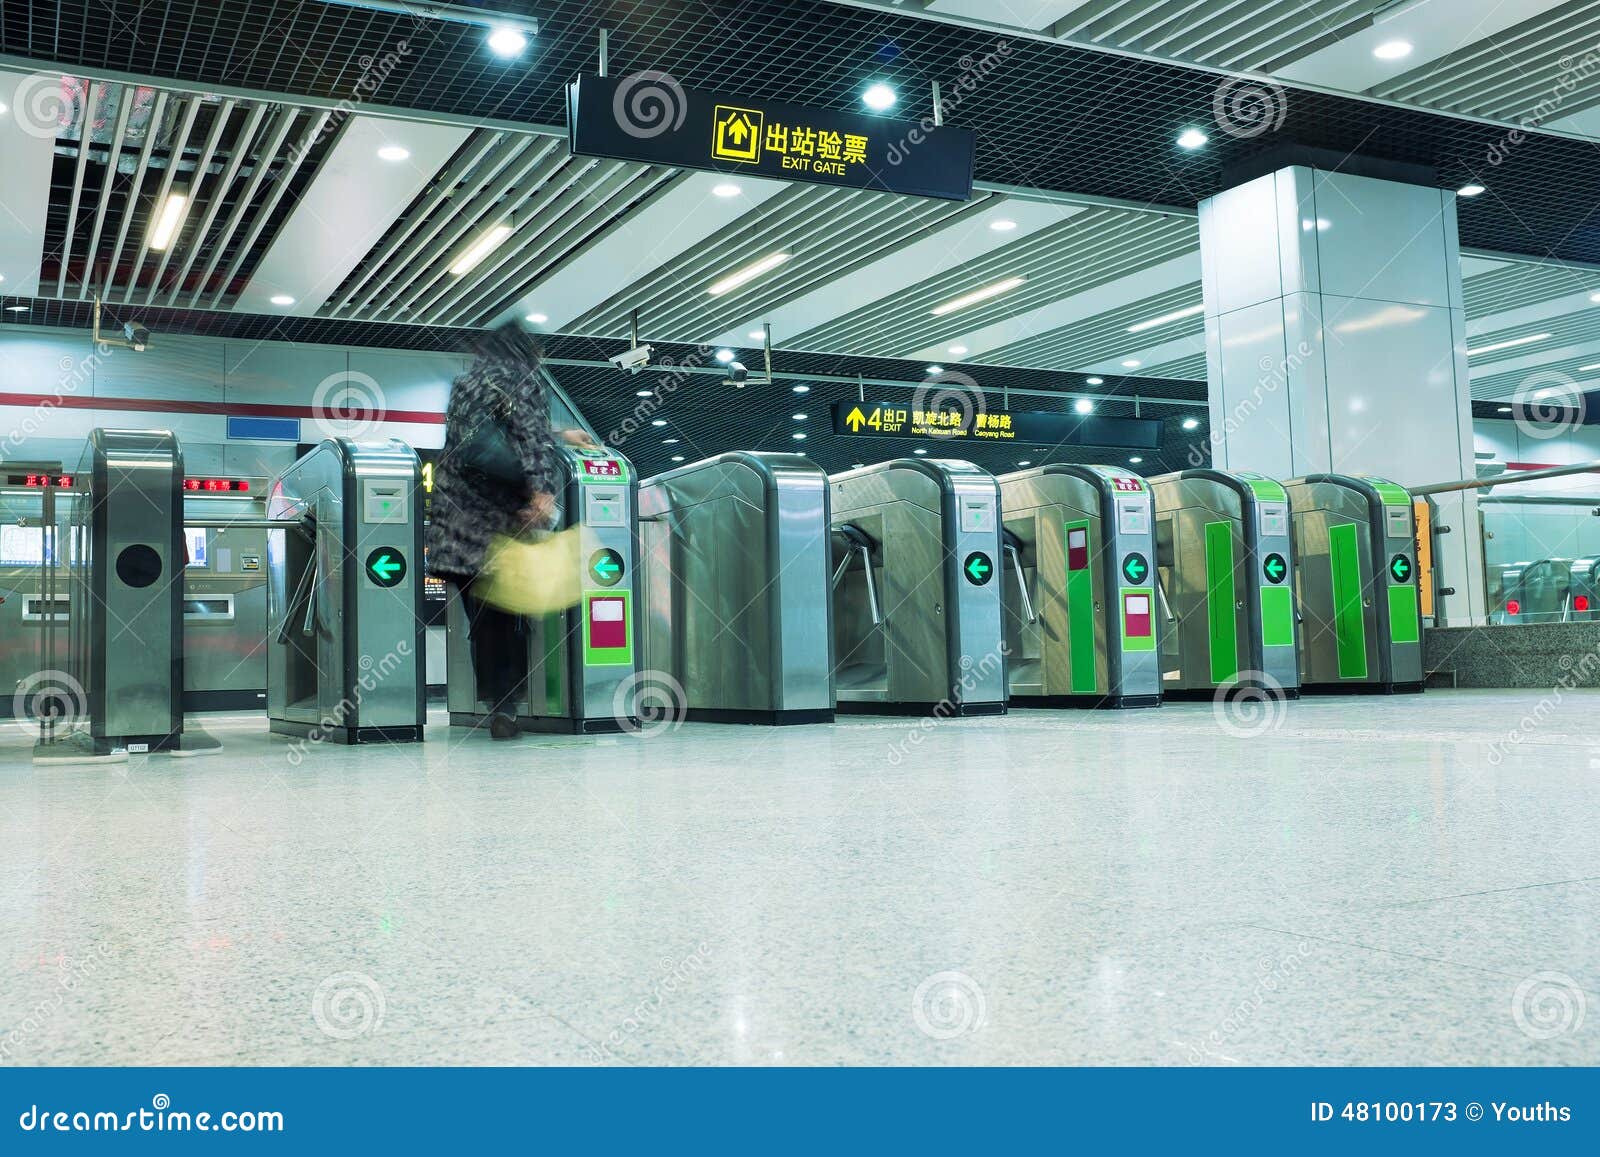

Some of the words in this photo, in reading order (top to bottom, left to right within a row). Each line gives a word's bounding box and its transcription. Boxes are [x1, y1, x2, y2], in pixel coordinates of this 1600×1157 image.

[765, 123, 868, 164] 出站验票
[782, 156, 810, 171] EXIT
[813, 160, 846, 176] GATE
[867, 407, 882, 431] 4
[883, 408, 906, 423] 出口
[912, 410, 962, 427] 凯旋北路
[976, 413, 1012, 429] 曹杨路
[883, 423, 902, 432] EXIT
[911, 427, 928, 435] North
[952, 428, 968, 436] Road
